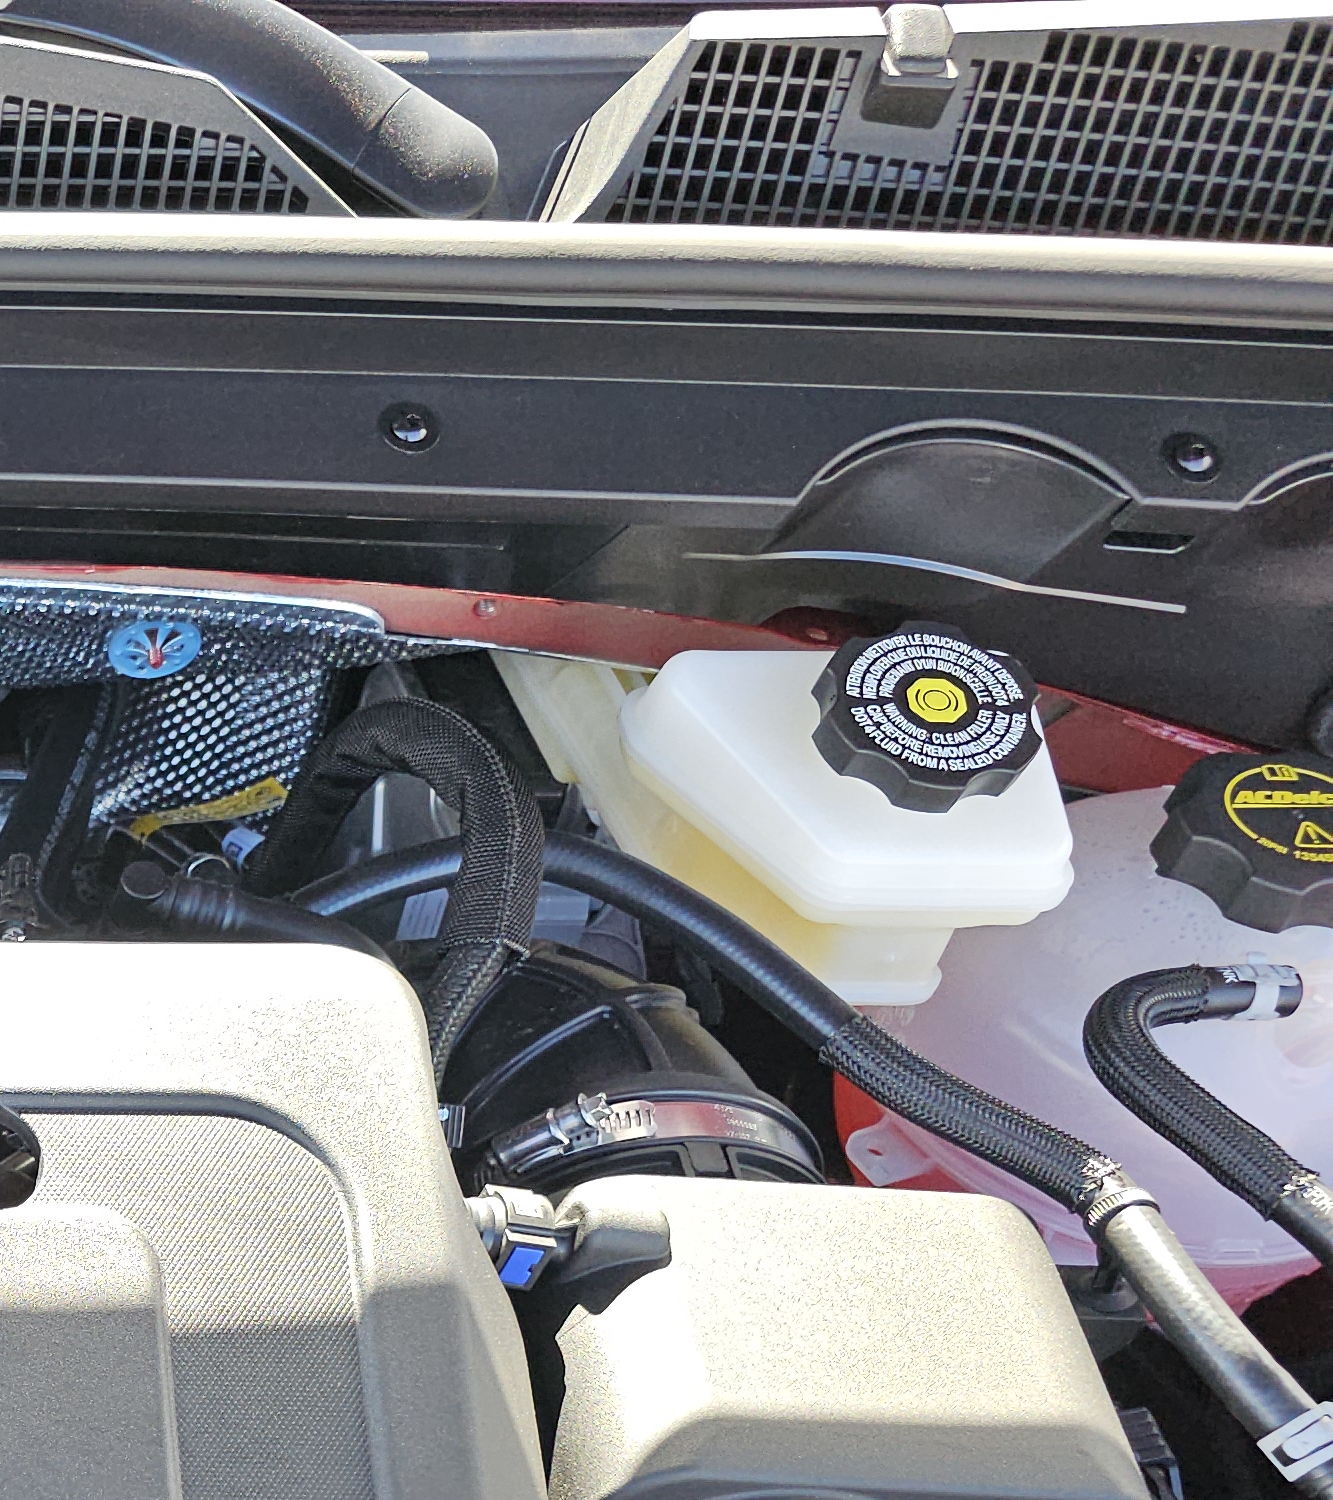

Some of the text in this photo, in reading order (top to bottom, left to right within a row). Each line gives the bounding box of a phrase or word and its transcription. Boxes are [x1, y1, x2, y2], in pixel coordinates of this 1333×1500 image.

[908, 633, 923, 646] LE
[923, 633, 971, 655] BOUCHON
[968, 648, 1002, 672] AVANT
[937, 659, 967, 680] BIDON
[957, 655, 975, 669] DE
[850, 706, 874, 726] DOT
[868, 729, 903, 756] FLUID
[900, 748, 938, 769] FROM
[938, 758, 949, 772] A
[948, 752, 994, 772] SEALED
[866, 704, 888, 724] CAP
[879, 721, 924, 753] BEFORE
[990, 710, 1011, 735] ONLY
[931, 730, 972, 745] CLEAN
[966, 709, 994, 738] FILLER
